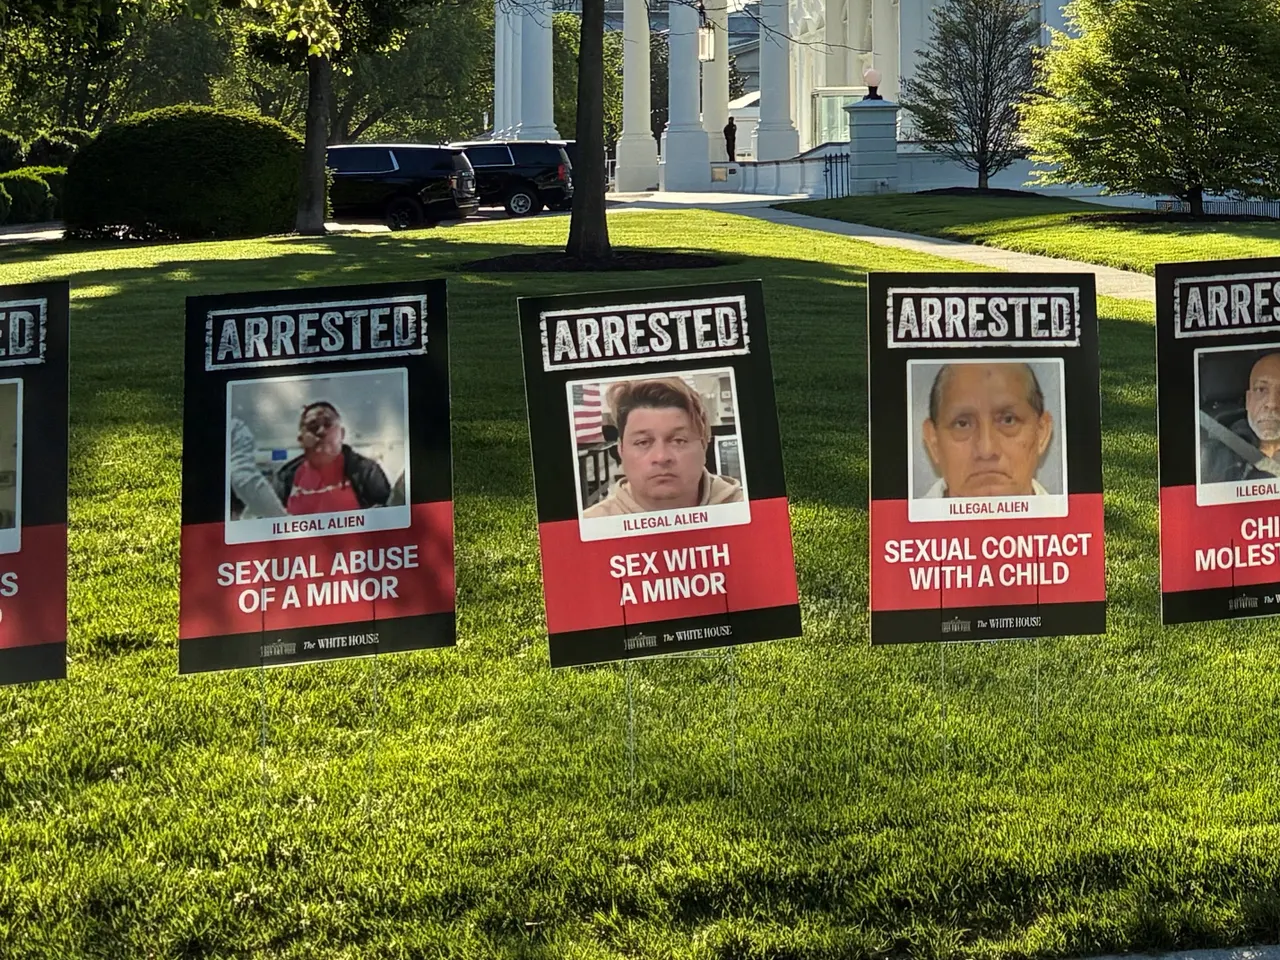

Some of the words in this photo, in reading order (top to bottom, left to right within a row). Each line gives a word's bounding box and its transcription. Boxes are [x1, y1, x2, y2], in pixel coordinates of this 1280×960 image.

[217, 306, 416, 360] ARRESTED
[897, 297, 1071, 339] ARRESTED
[554, 306, 739, 361] ARRESTED
[1236, 483, 1280, 498] ILLEGAL
[623, 515, 671, 532] ILLEGAL
[674, 511, 709, 527] ALIEN
[949, 503, 994, 515] ILLEGAL
[996, 501, 1029, 514] ALIEN
[272, 518, 325, 535] ILLEGAL
[328, 515, 365, 530] ALIEN
[609, 550, 657, 579] SEX
[664, 543, 730, 572] WITH
[884, 536, 977, 564] SEXUAL
[981, 532, 1092, 560] CONTACT
[217, 556, 324, 587] SEXUAL
[331, 545, 419, 577] ABUSE
[909, 563, 972, 591] WITH
[977, 564, 995, 588] A
[999, 561, 1069, 587] CHILD
[238, 586, 276, 614] OF
[282, 584, 300, 610] A
[307, 577, 399, 607] MINOR
[620, 581, 639, 606] A
[642, 572, 726, 603] MINOR
[1264, 595, 1274, 604] The
[663, 633, 675, 643] The
[676, 628, 702, 642] WHITE
[703, 625, 733, 639] HOUSE
[977, 619, 988, 629] The
[989, 617, 1014, 629] WHITE
[1015, 616, 1042, 628] HOUSE
[303, 640, 316, 650] The
[317, 637, 346, 649] WHITE
[347, 633, 379, 646] HOUSE
